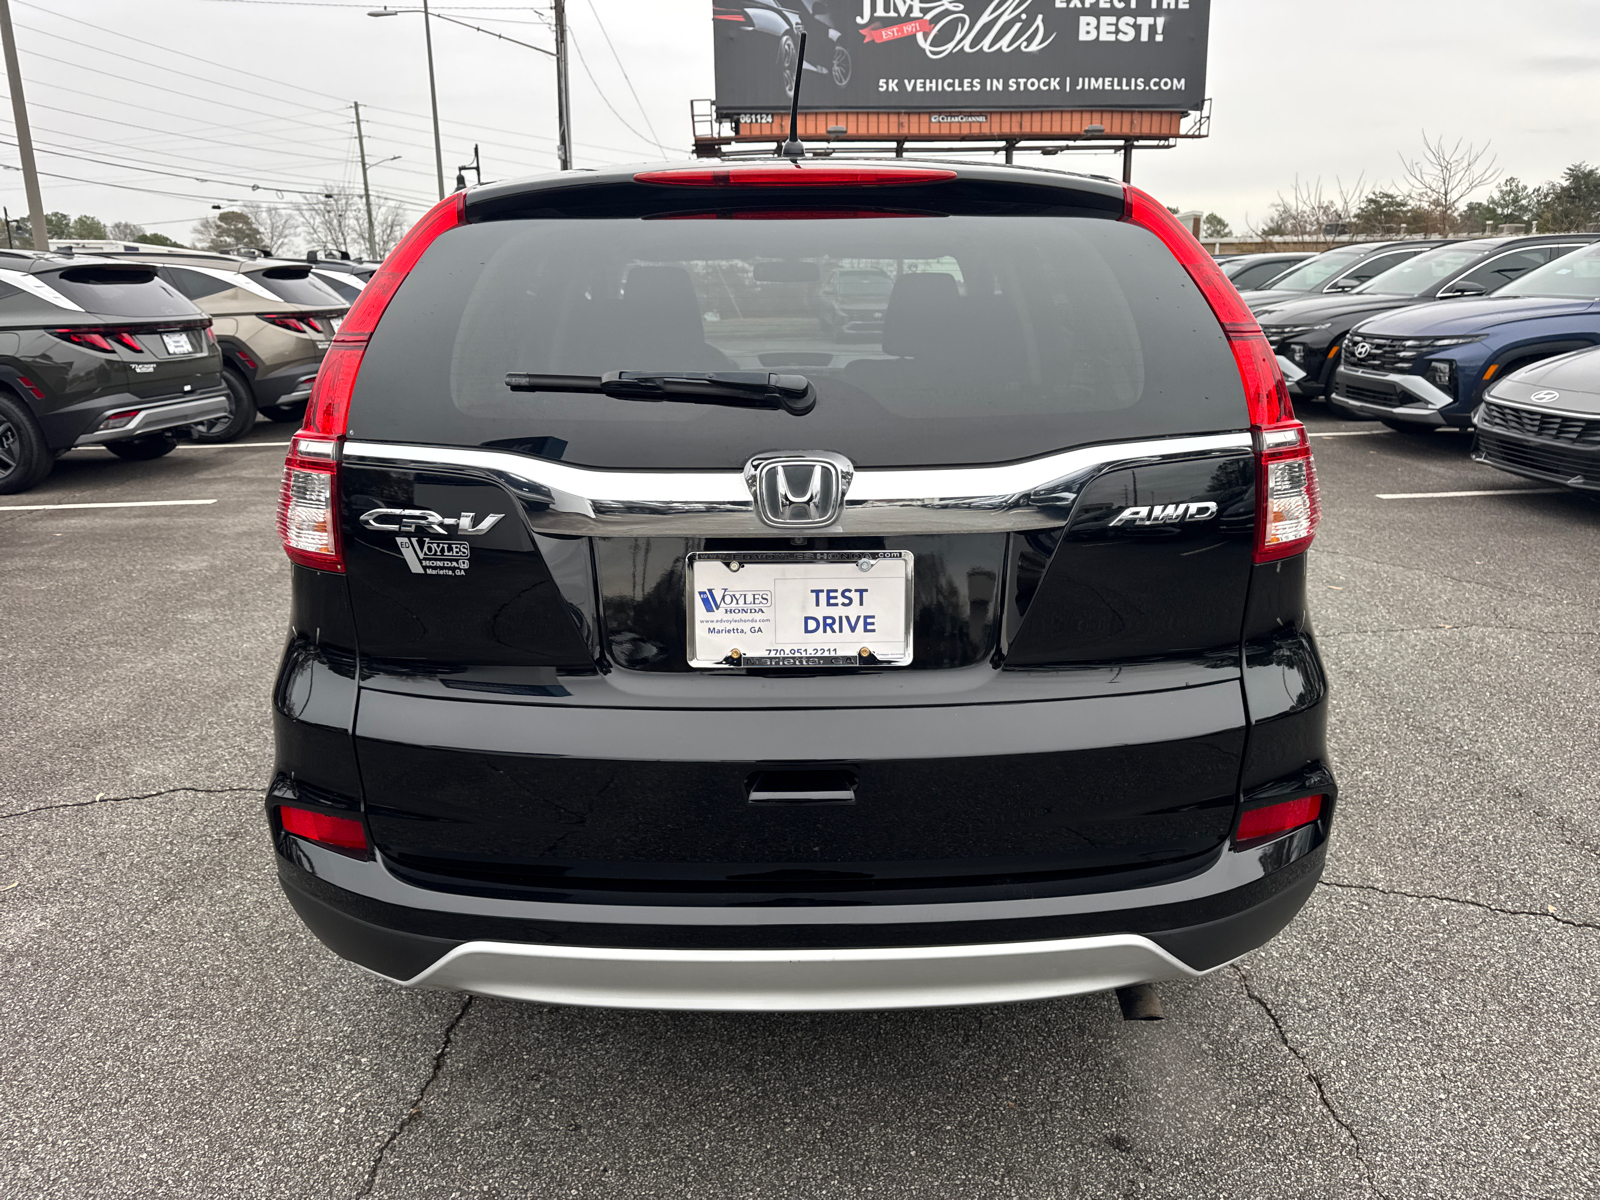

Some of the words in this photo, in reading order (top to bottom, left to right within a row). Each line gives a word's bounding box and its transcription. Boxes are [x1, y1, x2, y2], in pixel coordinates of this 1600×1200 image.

[855, 0, 924, 24] JIM
[915, 0, 1057, 59] Ellis
[881, 29, 902, 40] EST.
[903, 22, 921, 34] 1971
[1078, 15, 1165, 42] BEST!
[878, 78, 899, 92] 5K
[904, 78, 981, 92] VEHICLES
[986, 78, 1003, 92] IN
[1008, 77, 1061, 91] STOCK
[1075, 77, 1186, 91] JIMELLIS.COM
[740, 113, 773, 123] 061124
[359, 508, 506, 535] CR-V
[1108, 501, 1218, 527] AWD
[400, 541, 410, 549] ED
[410, 537, 469, 560] VOYLES
[426, 568, 454, 576] Marietta,
[706, 588, 769, 611] VOYLES
[810, 588, 868, 607] TEST
[700, 617, 771, 625] www.edvoyleshonda.com
[707, 627, 747, 635] Marietta,
[749, 626, 763, 634] GA
[803, 615, 876, 634] DRIVE
[746, 656, 824, 666] Marietta,
[830, 656, 856, 666] GA
